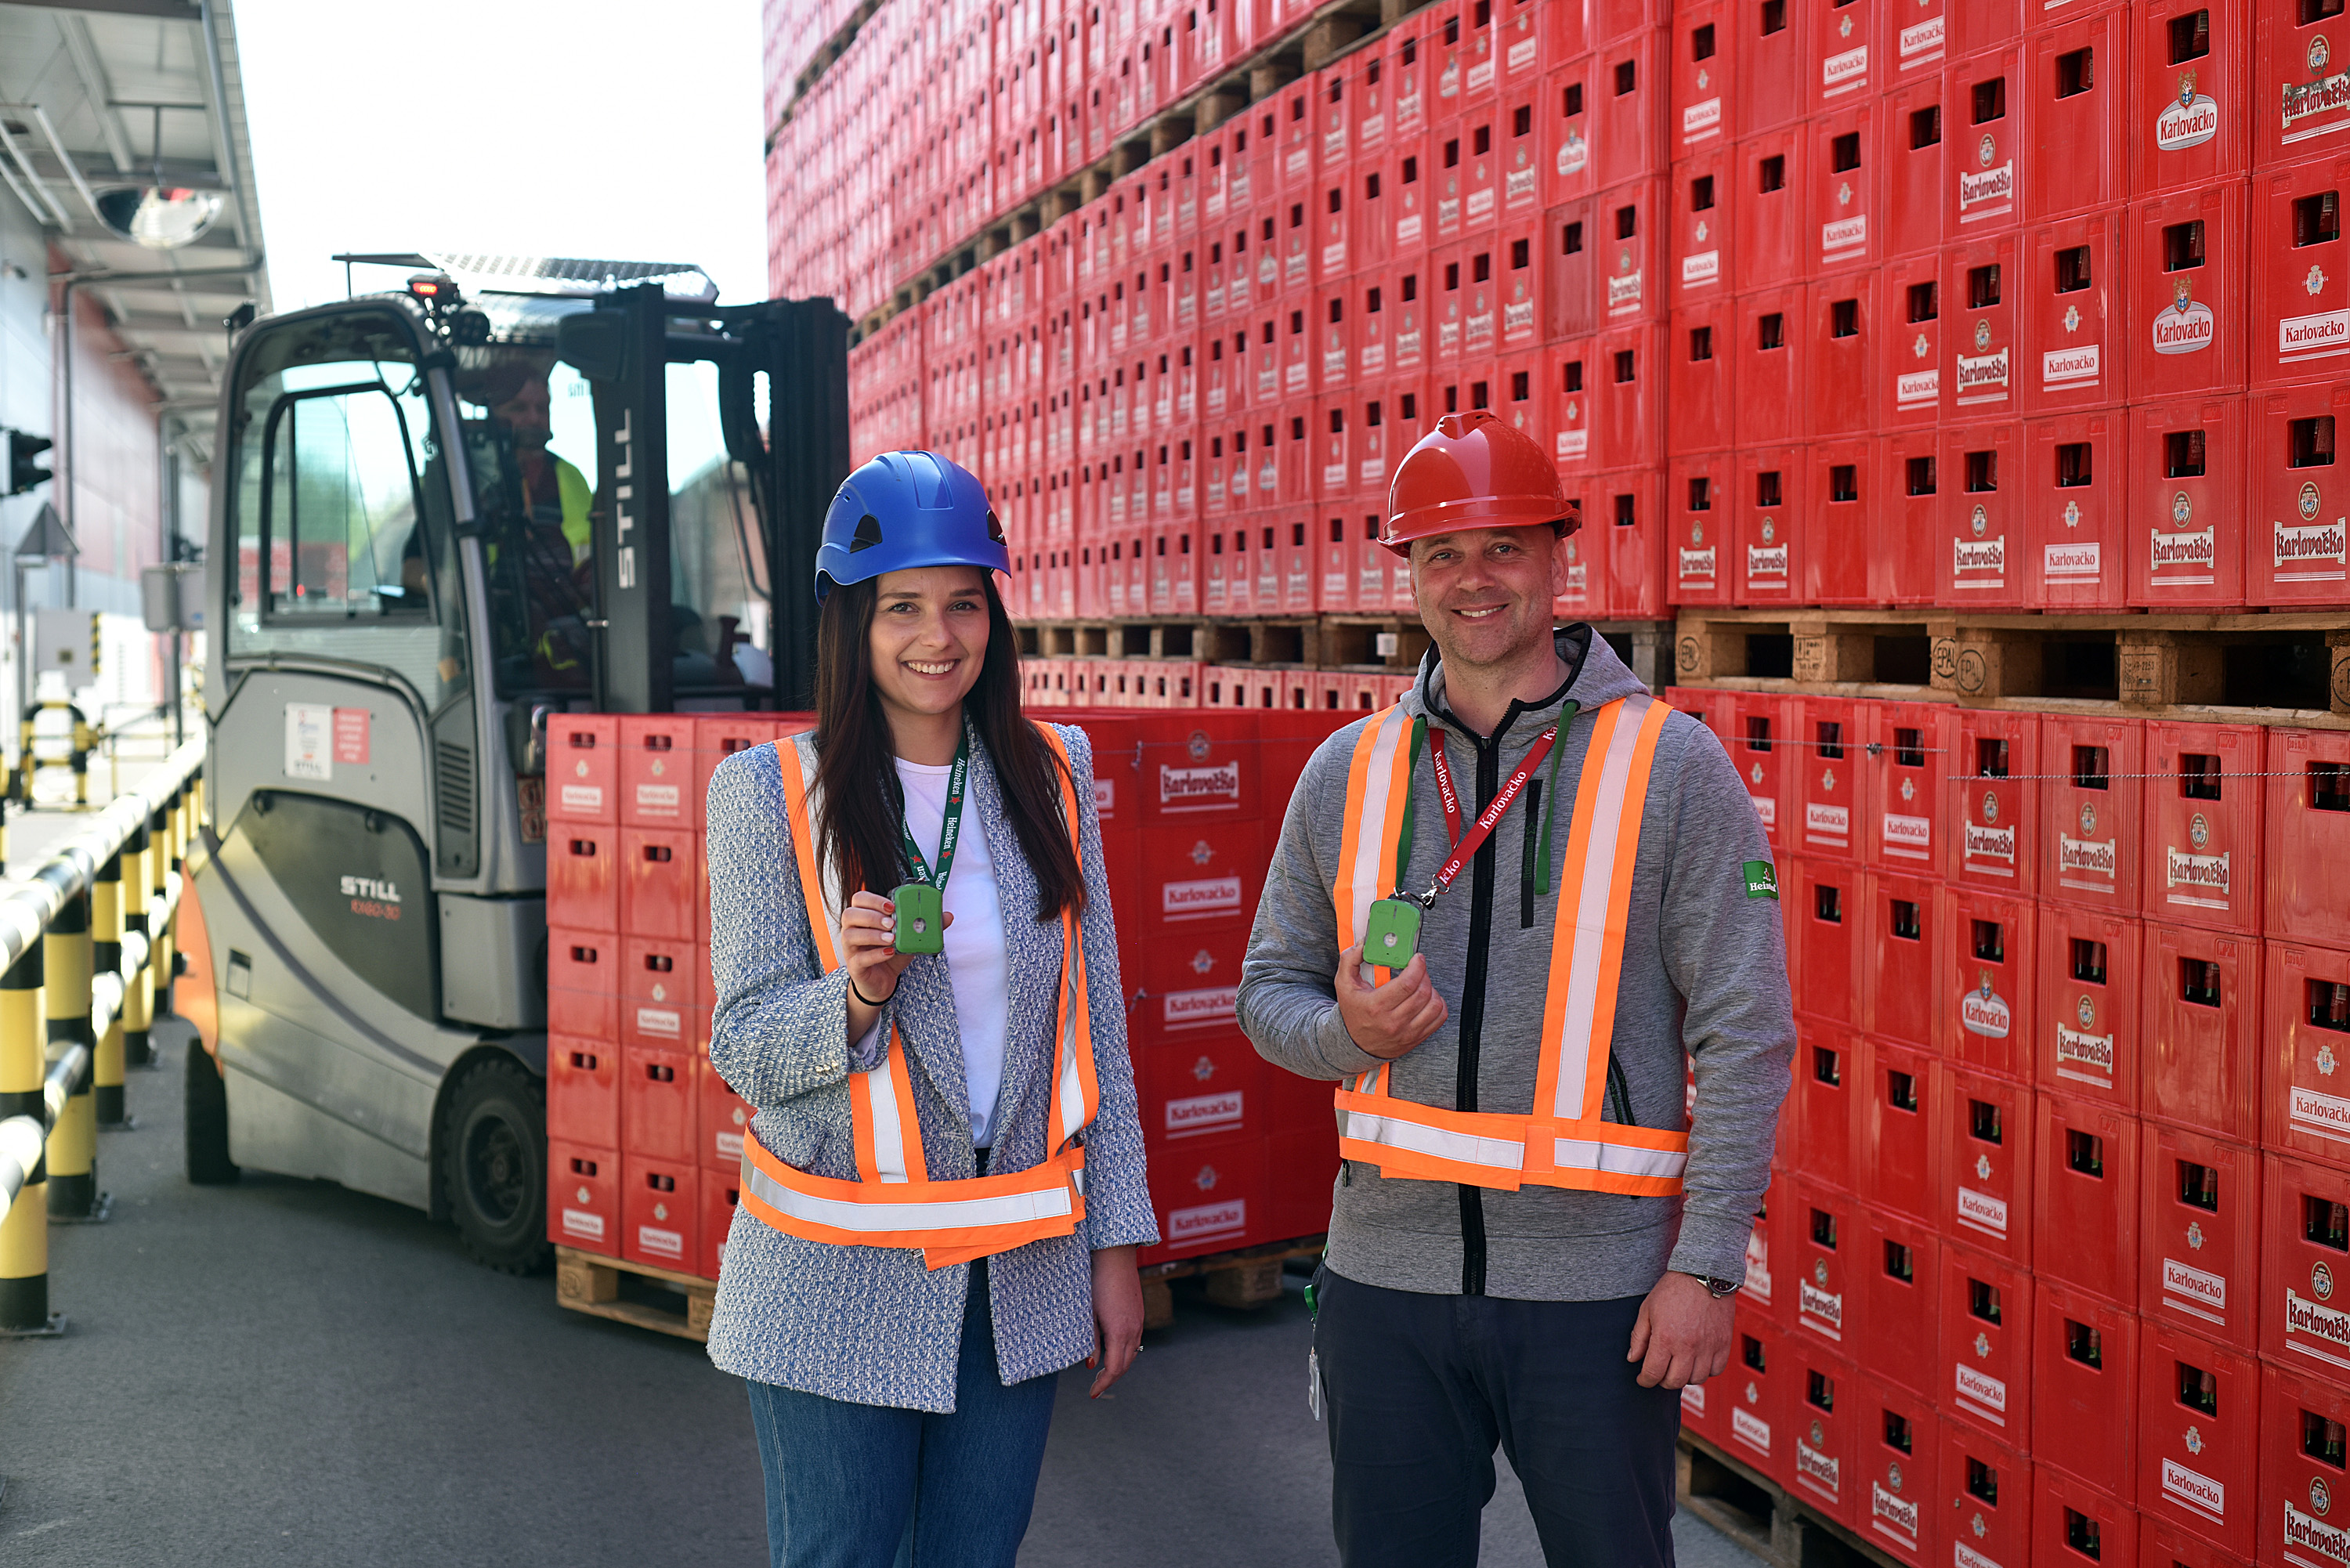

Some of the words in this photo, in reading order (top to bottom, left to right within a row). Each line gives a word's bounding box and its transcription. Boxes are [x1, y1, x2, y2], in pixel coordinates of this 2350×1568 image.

[2160, 108, 2214, 140] Karlovačko
[2157, 316, 2211, 344] Karlovačko
[2285, 320, 2345, 343] Karlovačko
[2048, 355, 2095, 374] Karlovačko
[615, 408, 636, 589] STILL
[2153, 536, 2213, 562] Karlovačko
[2276, 528, 2345, 558] Karlovačko
[2049, 551, 2095, 567] Karlovačko
[1960, 659, 1982, 683] EPAL
[952, 757, 966, 795] Heineken
[1434, 750, 1455, 814] Karlovačko
[1479, 771, 1528, 830] Karlovačko
[943, 817, 958, 850] Heineken
[1888, 821, 1927, 839] Karlovačko
[2062, 841, 2114, 870] Karlovačko
[2170, 855, 2229, 886] Karlovačko
[341, 875, 401, 902] STILL
[1963, 1196, 2004, 1222] Karlovačko
[2168, 1267, 2222, 1299] Karlovačko
[2288, 1299, 2350, 1343] Karlovačk
[1960, 1371, 2003, 1403] Karlovačko
[2167, 1469, 2219, 1504] Karlovačko
